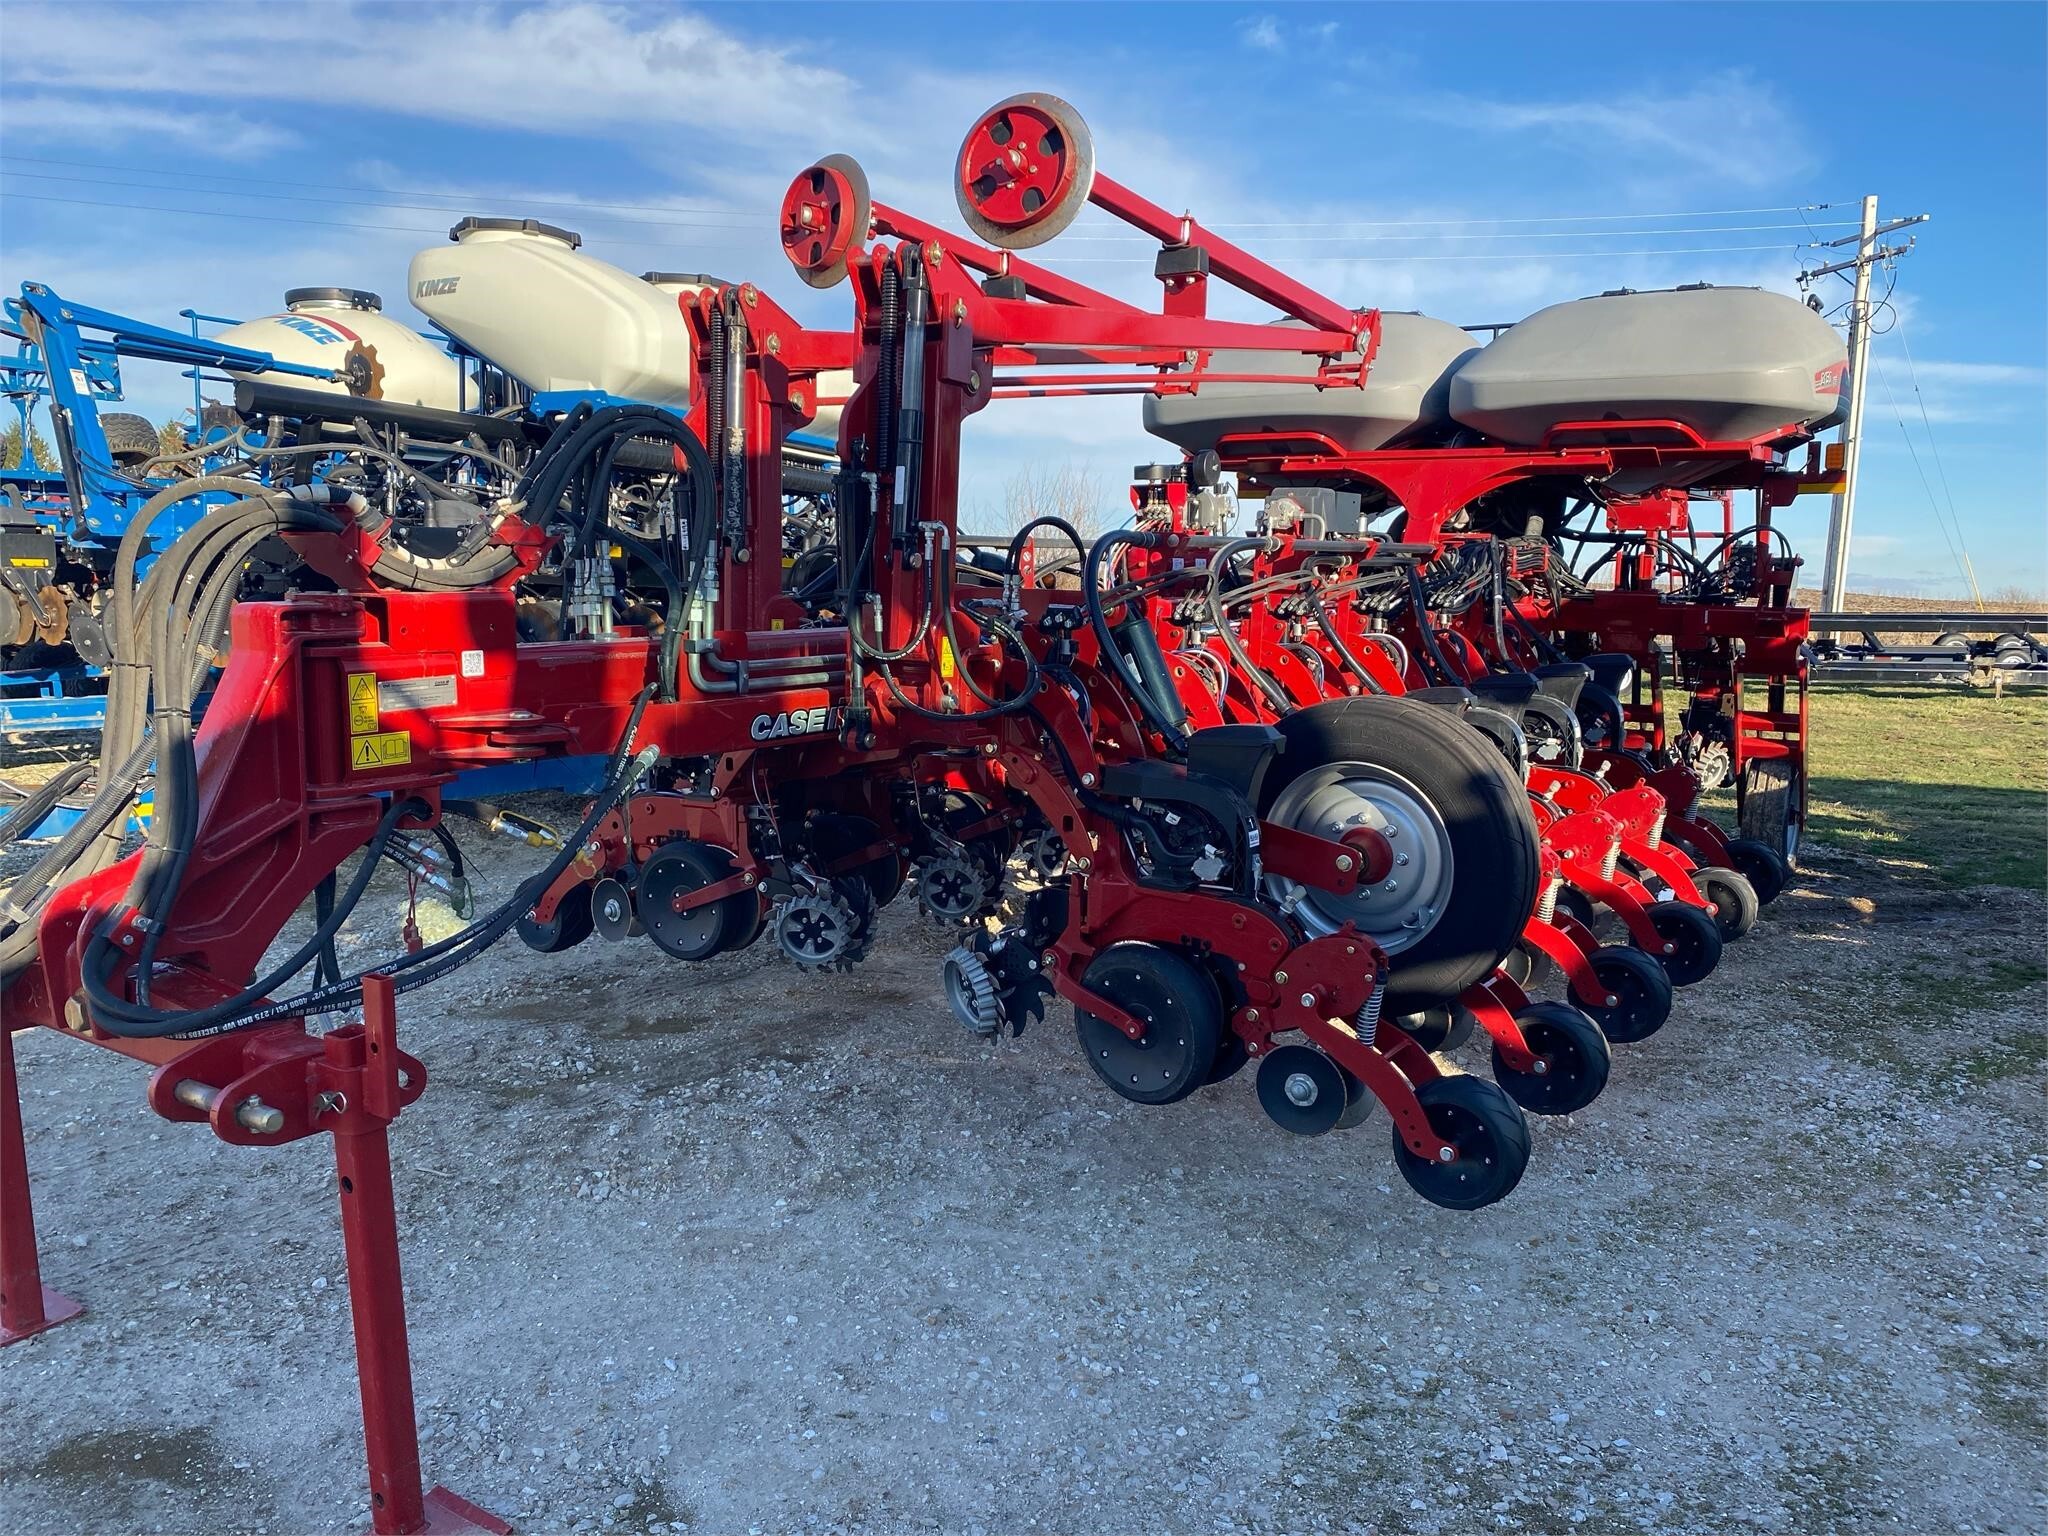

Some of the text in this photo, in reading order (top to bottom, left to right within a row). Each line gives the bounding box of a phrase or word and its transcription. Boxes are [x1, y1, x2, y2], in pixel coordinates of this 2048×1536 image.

[416, 276, 461, 299] KINZE
[273, 316, 345, 346] KINZE
[750, 707, 828, 742] CASE
[275, 1003, 289, 1014] PSI
[290, 996, 308, 1008] 4000
[236, 1015, 254, 1028] BAR
[254, 1010, 270, 1021] 275
[188, 1026, 219, 1039] EXCEEDS
[222, 1021, 237, 1031] WP
